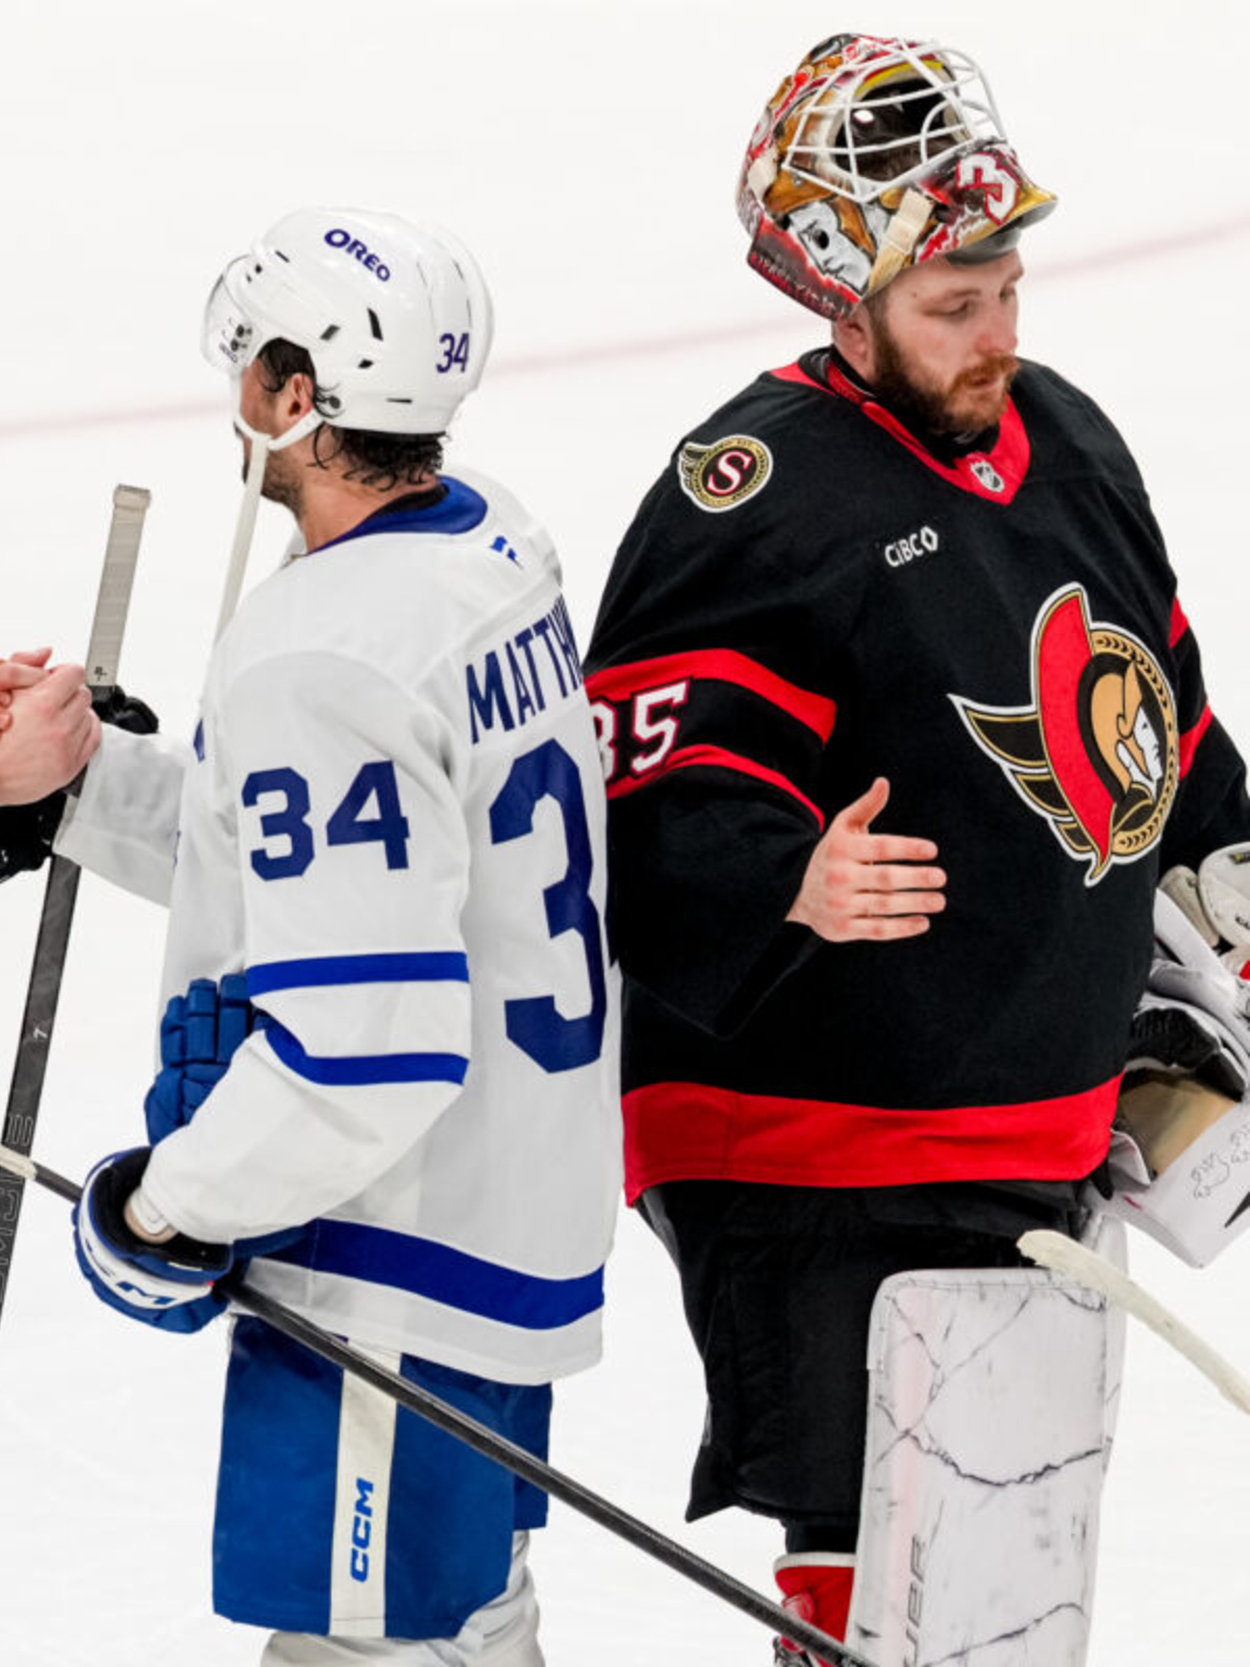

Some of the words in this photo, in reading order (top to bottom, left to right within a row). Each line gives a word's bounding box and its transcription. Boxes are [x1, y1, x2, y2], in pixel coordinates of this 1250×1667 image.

[324, 228, 390, 282] OREO
[436, 332, 470, 374] 34
[885, 533, 923, 567] CIBC
[241, 760, 410, 881] 34
[489, 738, 607, 1073] 3
[350, 1477, 374, 1583] CCM
